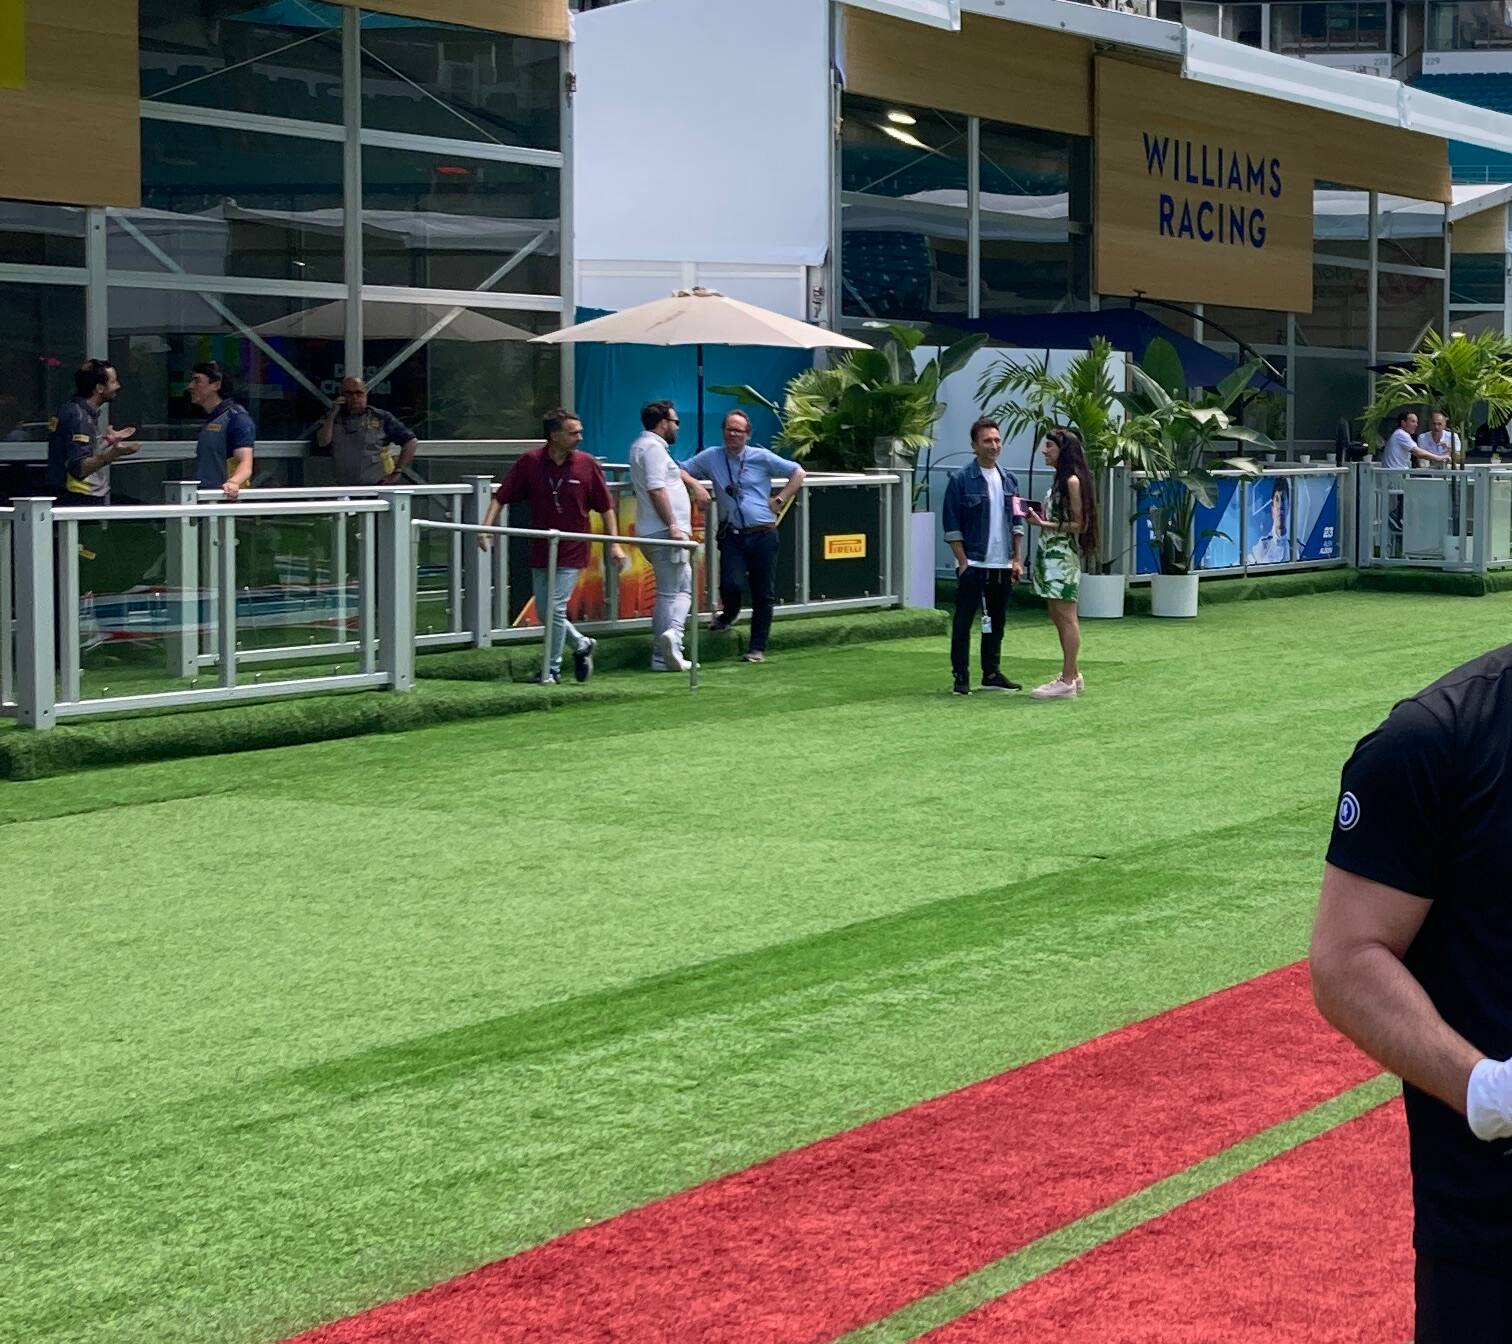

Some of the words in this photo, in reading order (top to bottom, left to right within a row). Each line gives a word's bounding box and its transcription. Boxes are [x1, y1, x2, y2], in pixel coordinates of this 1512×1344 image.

[1142, 131, 1282, 200] WILLIAMS
[1158, 194, 1267, 249] RACING
[828, 538, 863, 555] PIRELLI
